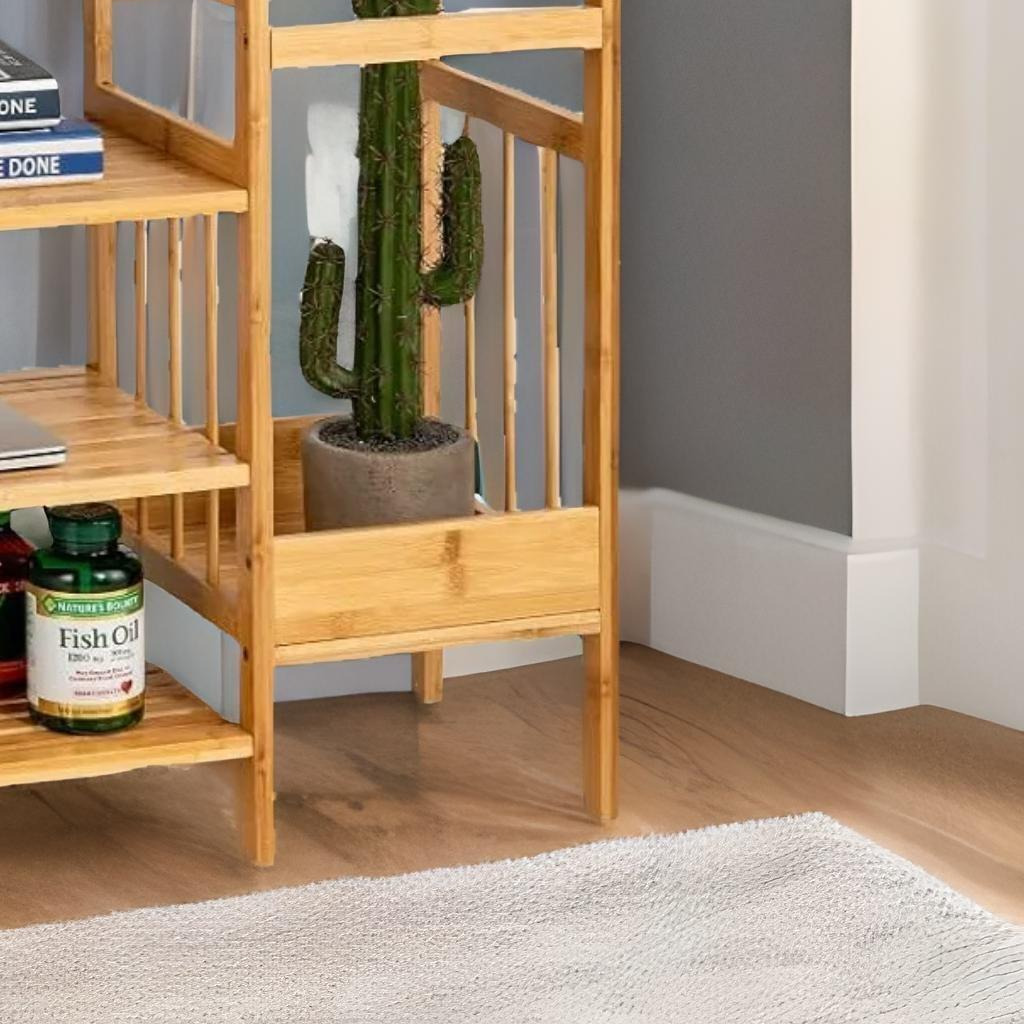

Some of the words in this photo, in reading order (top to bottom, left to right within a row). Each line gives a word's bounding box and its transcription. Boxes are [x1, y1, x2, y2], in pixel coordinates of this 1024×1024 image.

[9, 156, 61, 176] DONE
[59, 627, 108, 649] Fish
[111, 619, 139, 646] Oil
